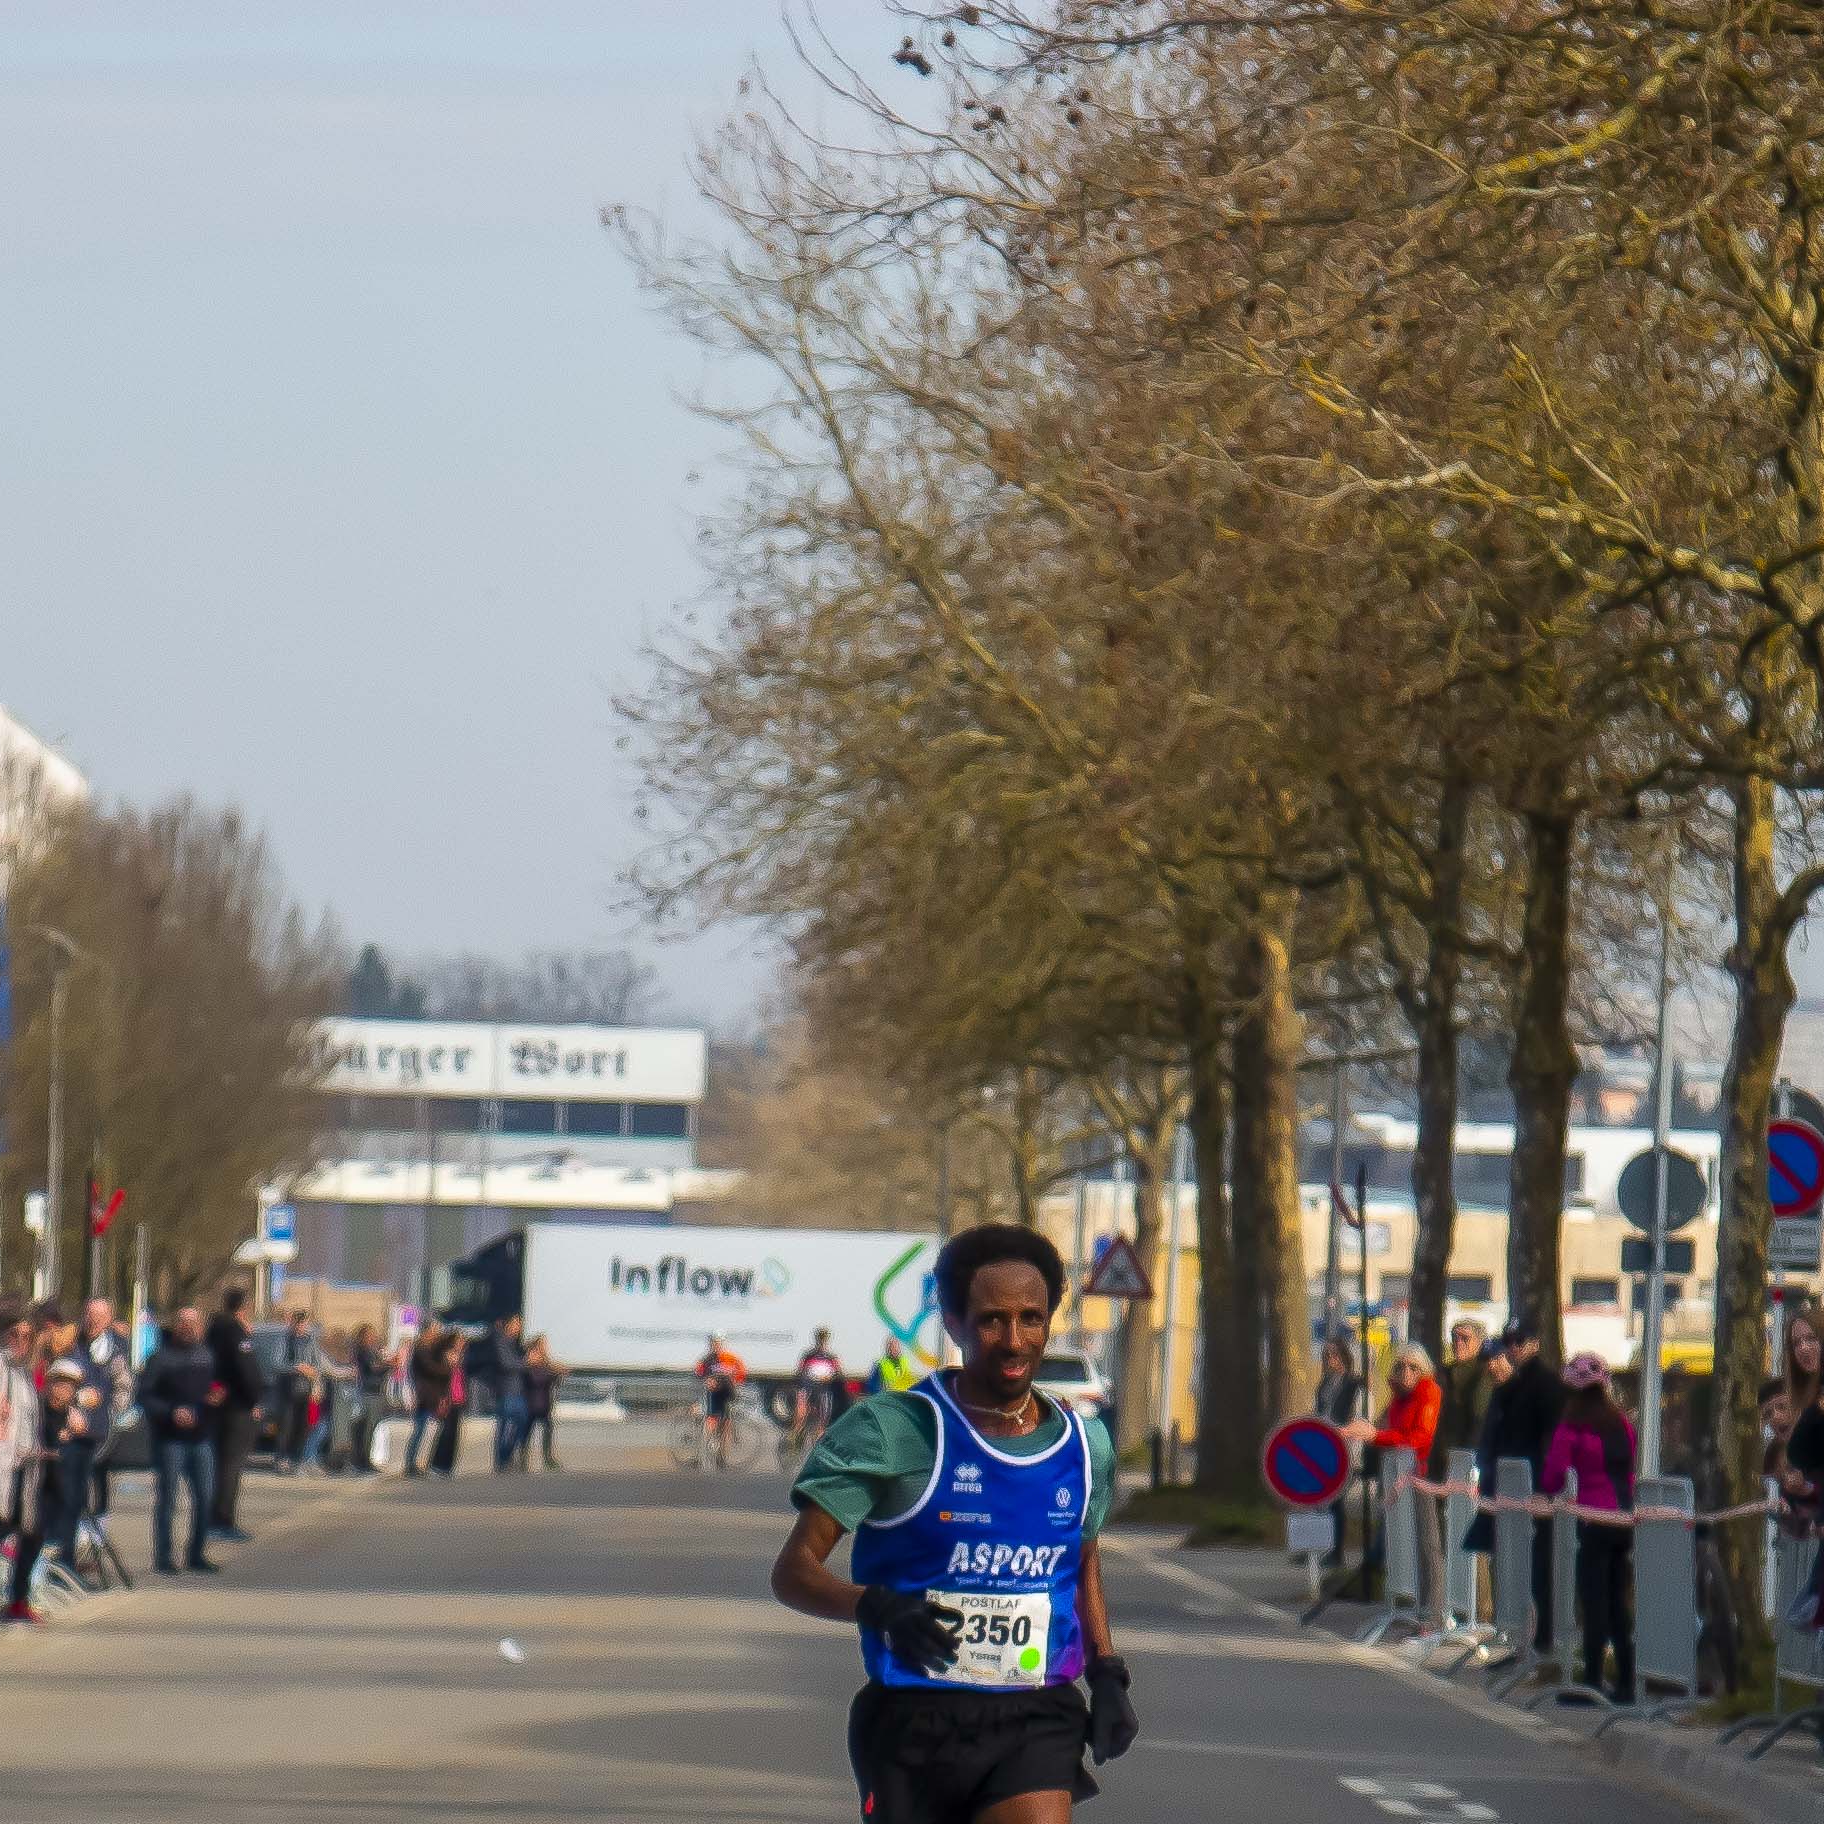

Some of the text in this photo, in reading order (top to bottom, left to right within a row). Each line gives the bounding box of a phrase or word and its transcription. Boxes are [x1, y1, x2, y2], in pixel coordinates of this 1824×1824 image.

[509, 1038, 629, 1077] Wort
[610, 1254, 754, 1296] Inflow
[947, 1541, 1067, 1577] ASPORT
